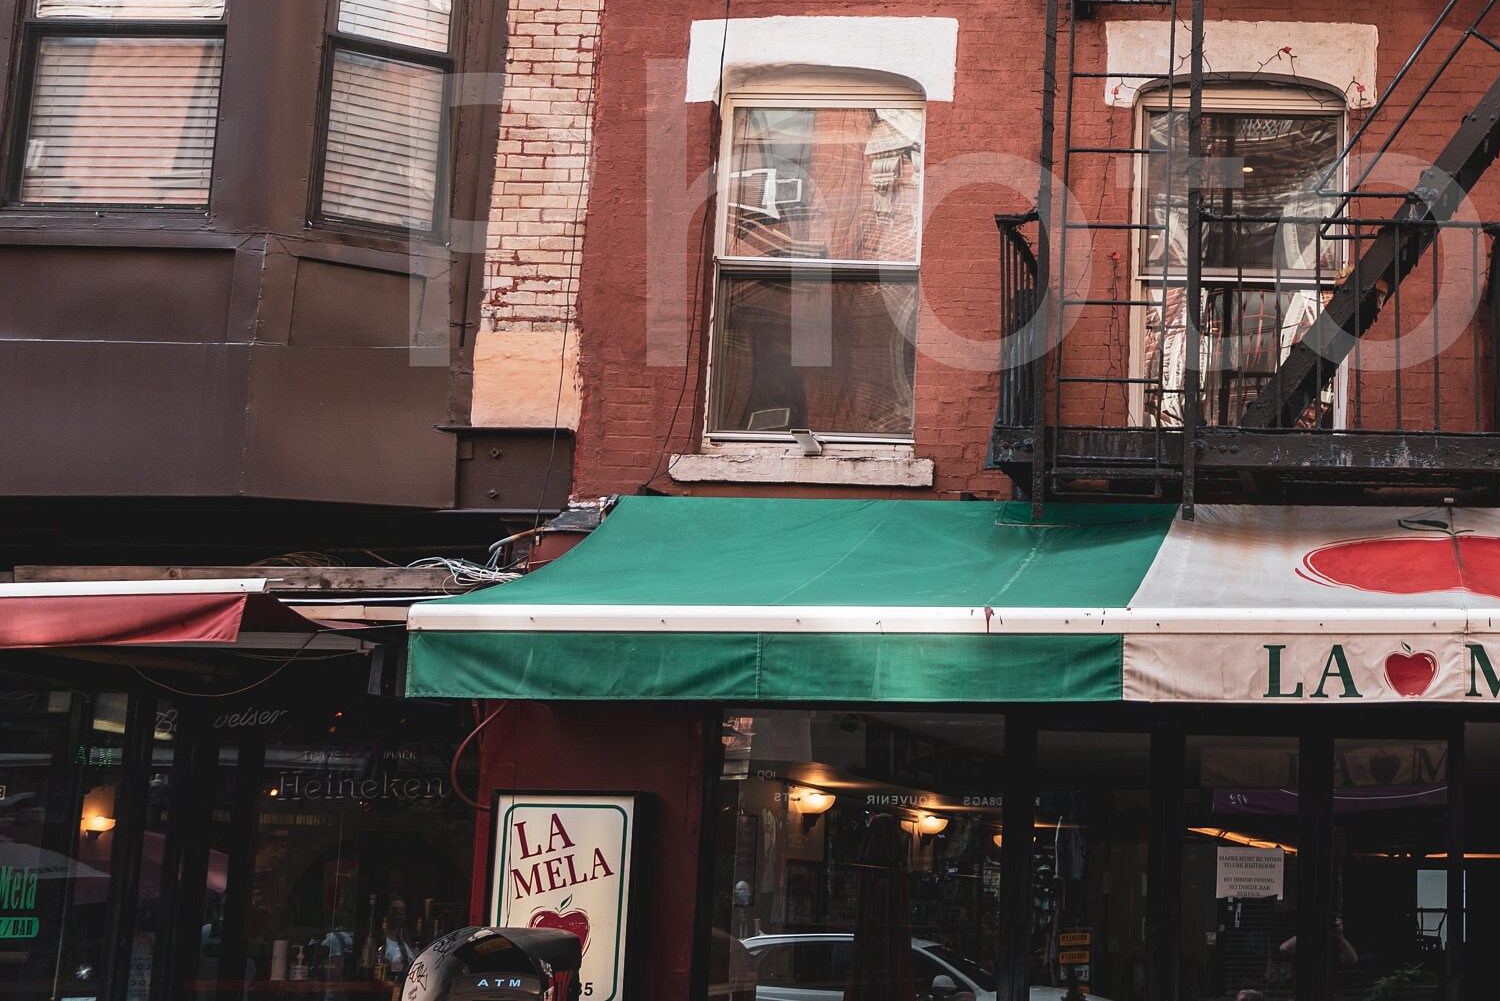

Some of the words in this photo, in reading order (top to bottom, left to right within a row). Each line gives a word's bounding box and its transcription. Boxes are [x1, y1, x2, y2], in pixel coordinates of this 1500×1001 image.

[1263, 644, 1364, 699] LA
[277, 770, 446, 801] Heineken
[513, 812, 576, 860] LA
[510, 847, 615, 900] MELA
[476, 979, 521, 988] ATM
